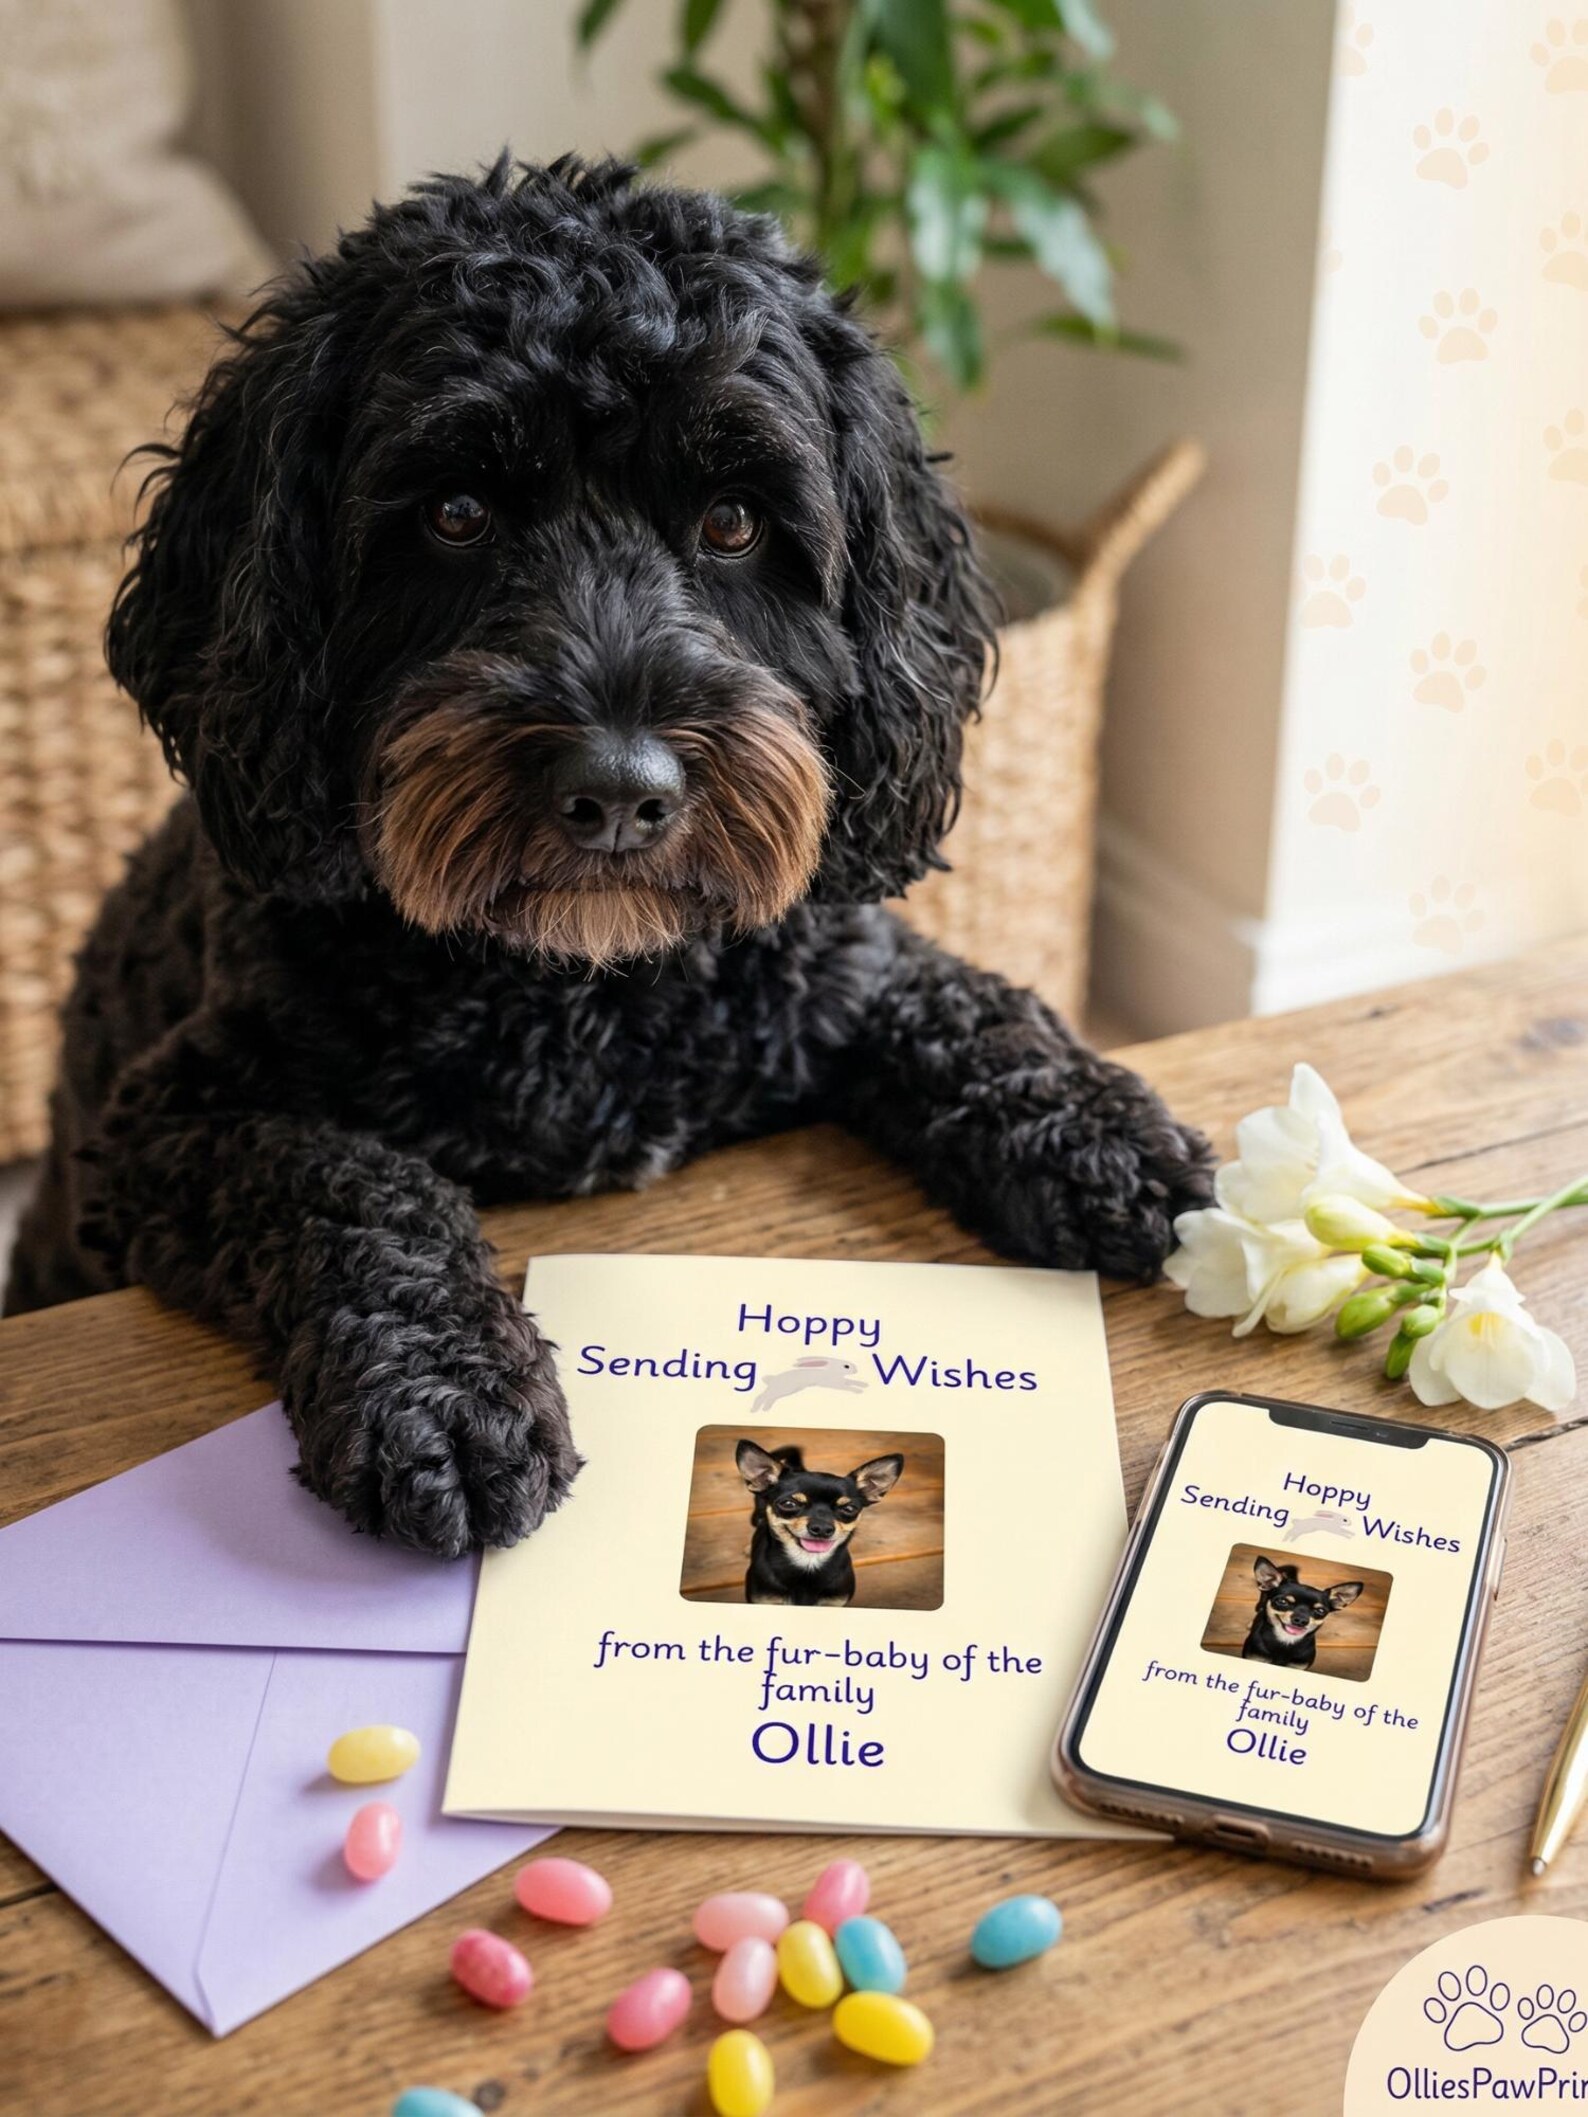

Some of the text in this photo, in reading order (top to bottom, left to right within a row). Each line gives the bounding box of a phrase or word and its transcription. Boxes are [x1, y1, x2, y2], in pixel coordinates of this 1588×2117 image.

[738, 1303, 881, 1348] Hoppy
[577, 1345, 1038, 1392] Sending Wishes
[1283, 1472, 1372, 1511] Hoppy
[1180, 1485, 1461, 1553] Sending Wishes
[593, 1630, 1043, 1682] from the fur-baby of the
[757, 1672, 874, 1715] family
[1142, 1660, 1419, 1730] from the fur-baby of the
[1235, 1698, 1309, 1736] family
[750, 1720, 885, 1768] Ollie
[1226, 1728, 1307, 1766] Ollie
